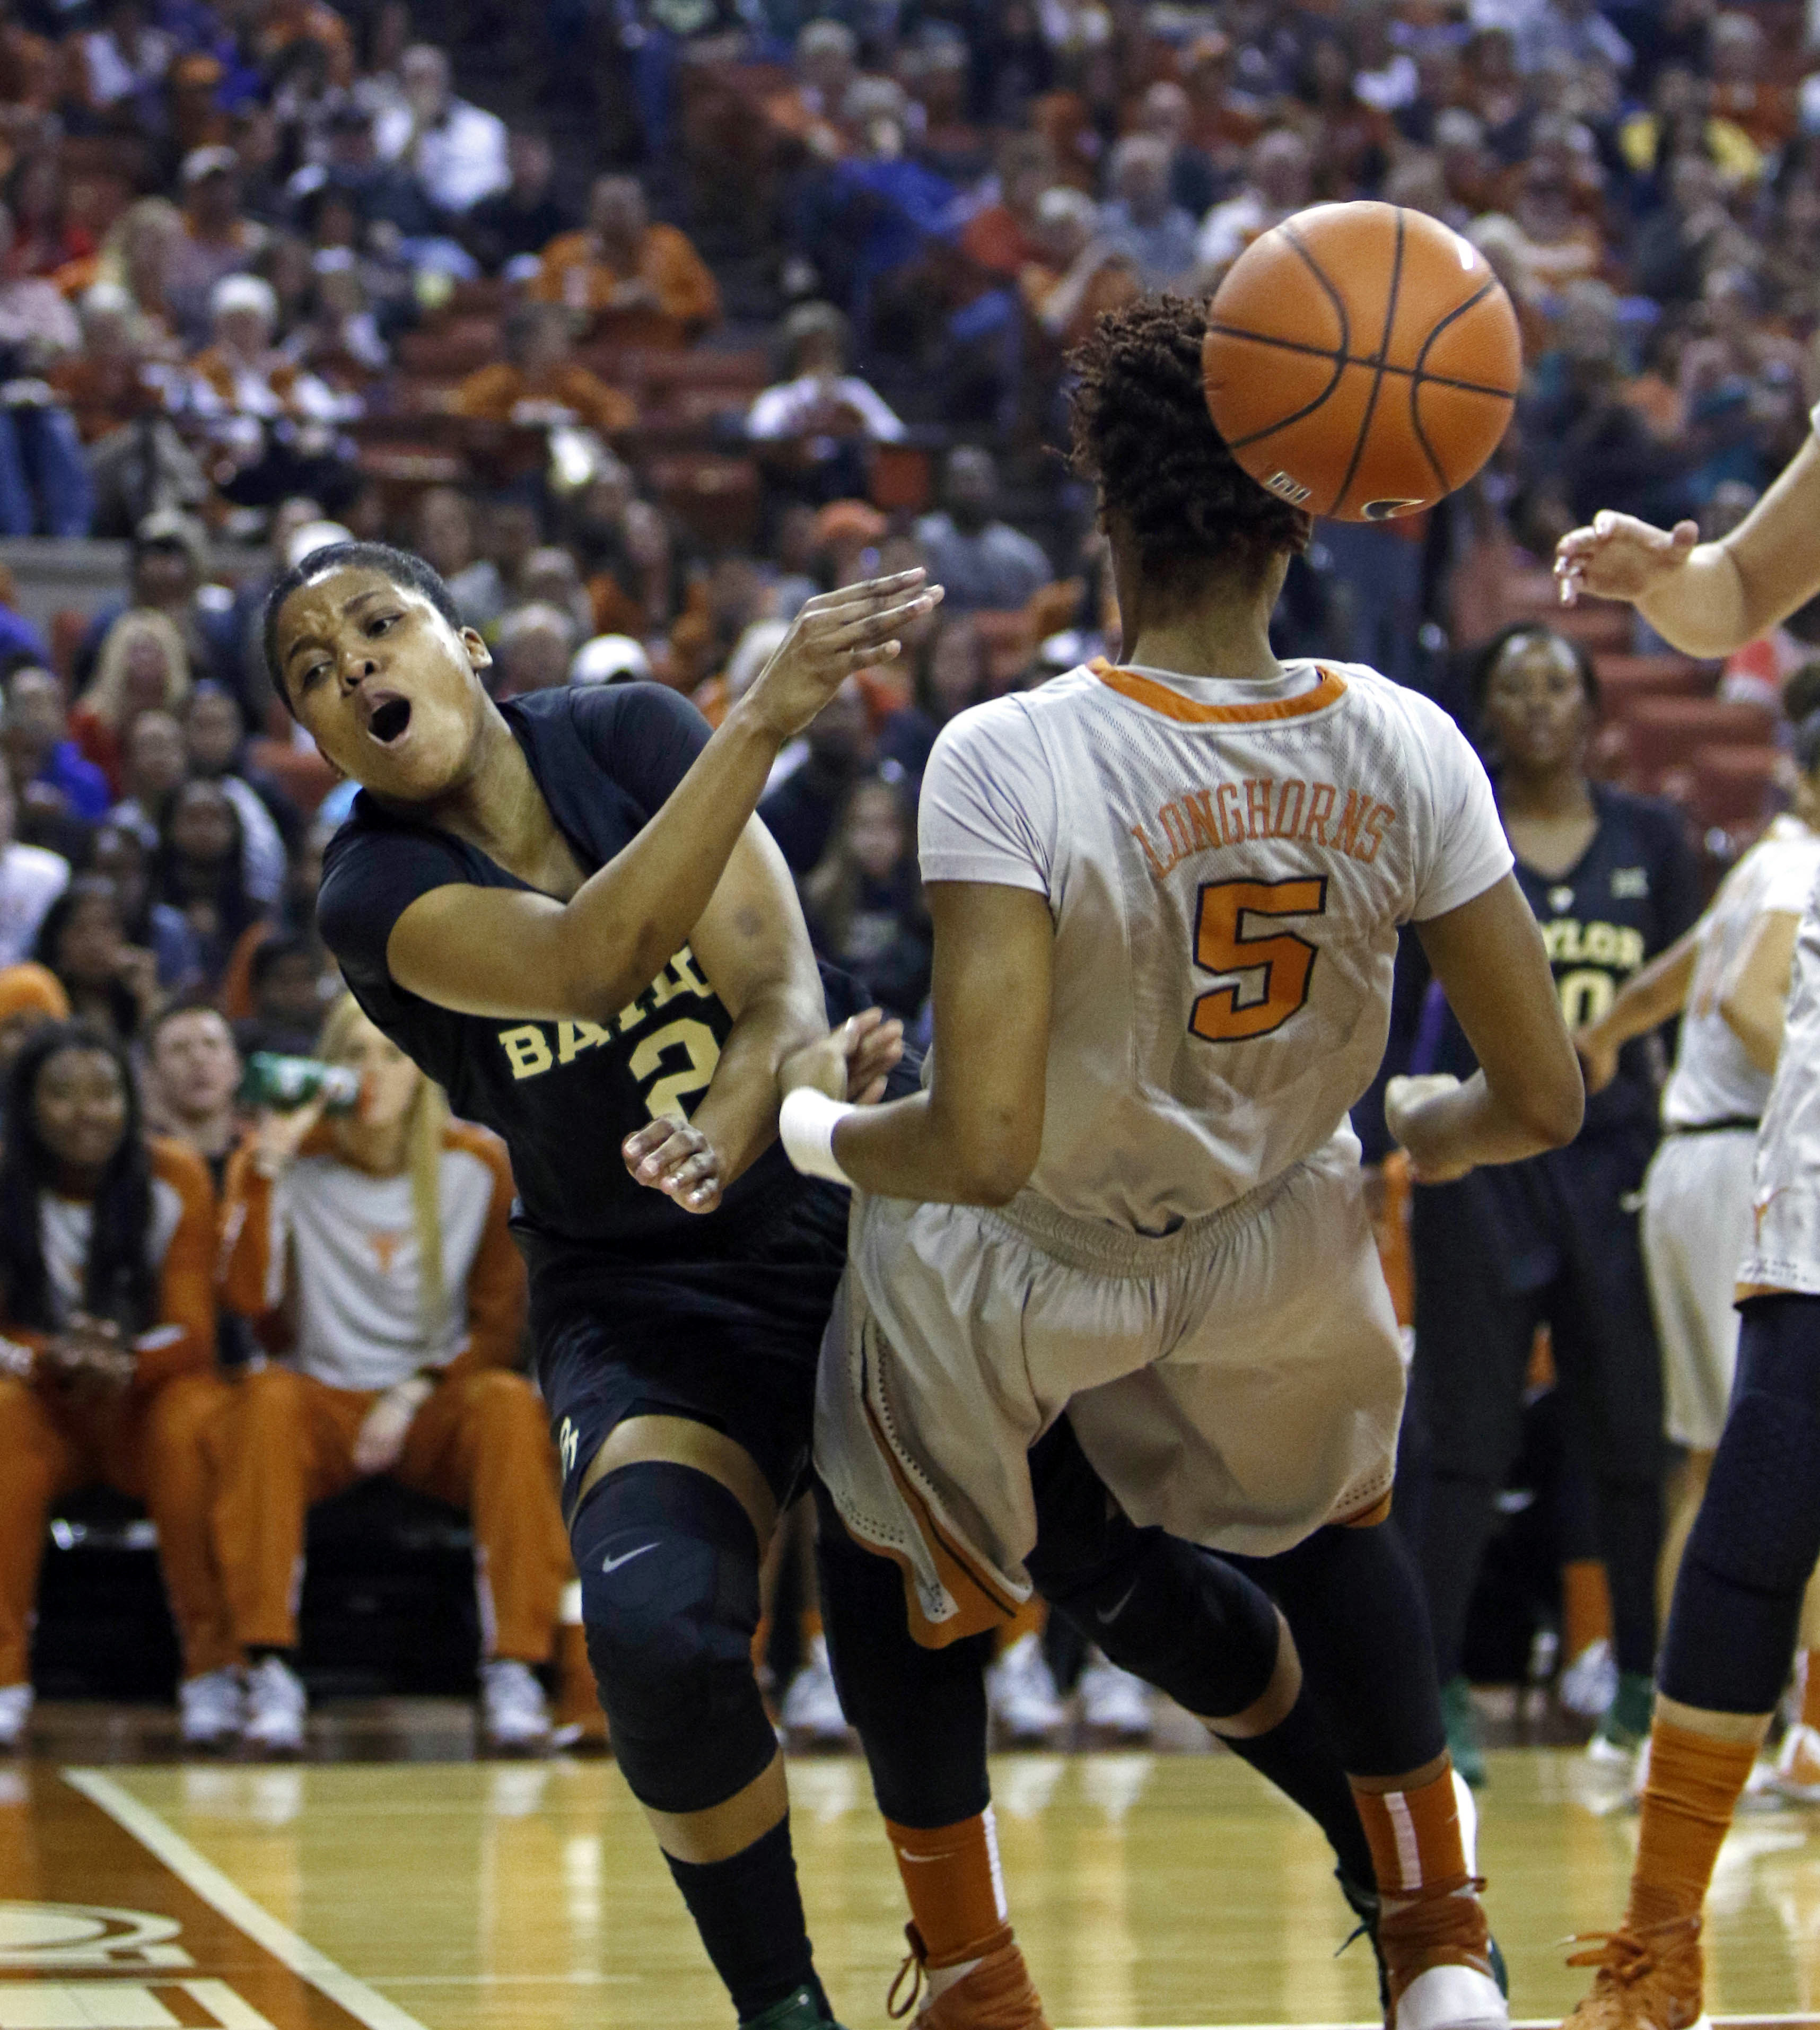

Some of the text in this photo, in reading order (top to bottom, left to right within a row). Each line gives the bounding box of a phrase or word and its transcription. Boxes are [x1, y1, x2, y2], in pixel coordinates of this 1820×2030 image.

[1131, 778, 1396, 880] LONGHORNS
[1187, 875, 1328, 1043] 5
[629, 1018, 721, 1121] 2
